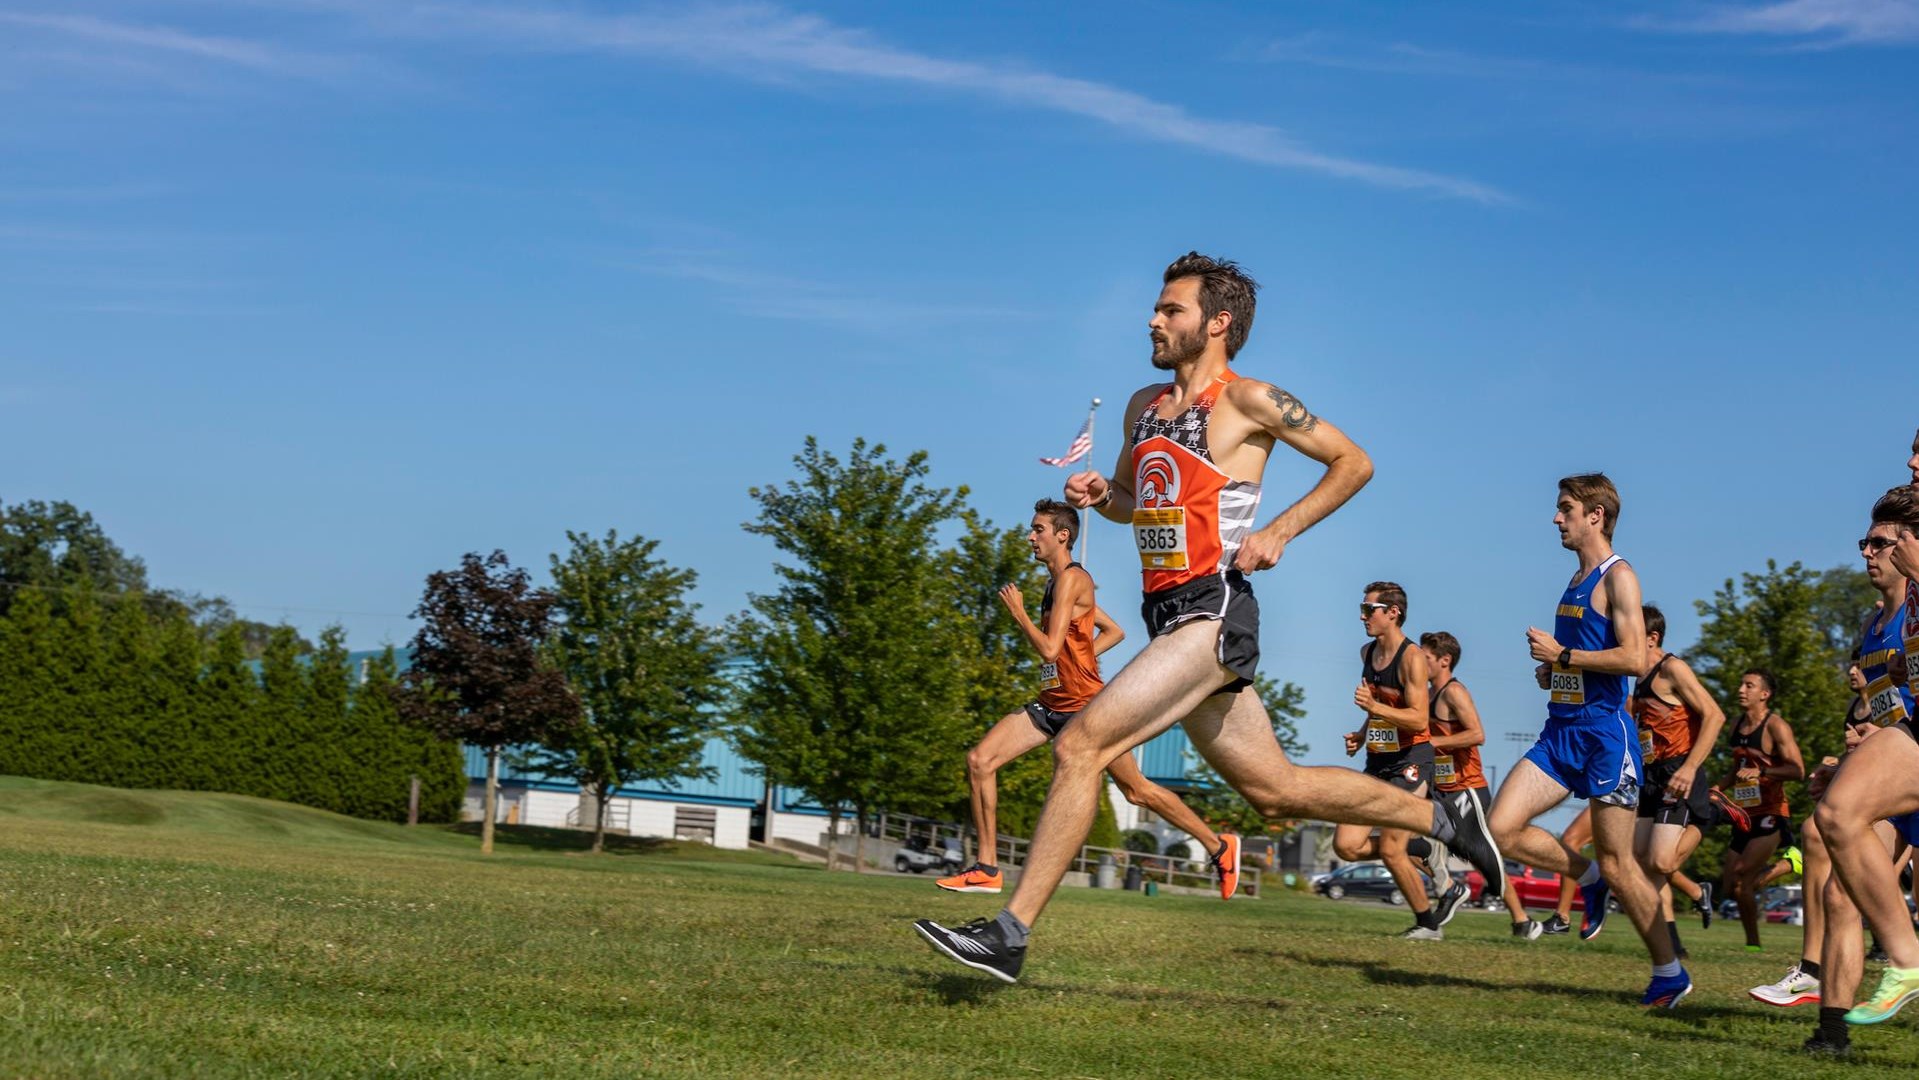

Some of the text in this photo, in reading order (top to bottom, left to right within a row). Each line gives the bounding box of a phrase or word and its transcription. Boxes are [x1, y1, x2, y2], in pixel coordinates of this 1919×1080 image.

[1140, 528, 1177, 549] 5863
[1040, 664, 1055, 679] 892
[1552, 675, 1579, 691] 6083
[1871, 691, 1897, 716] 6081
[1368, 730, 1394, 742] 5900
[1435, 764, 1450, 775] 894
